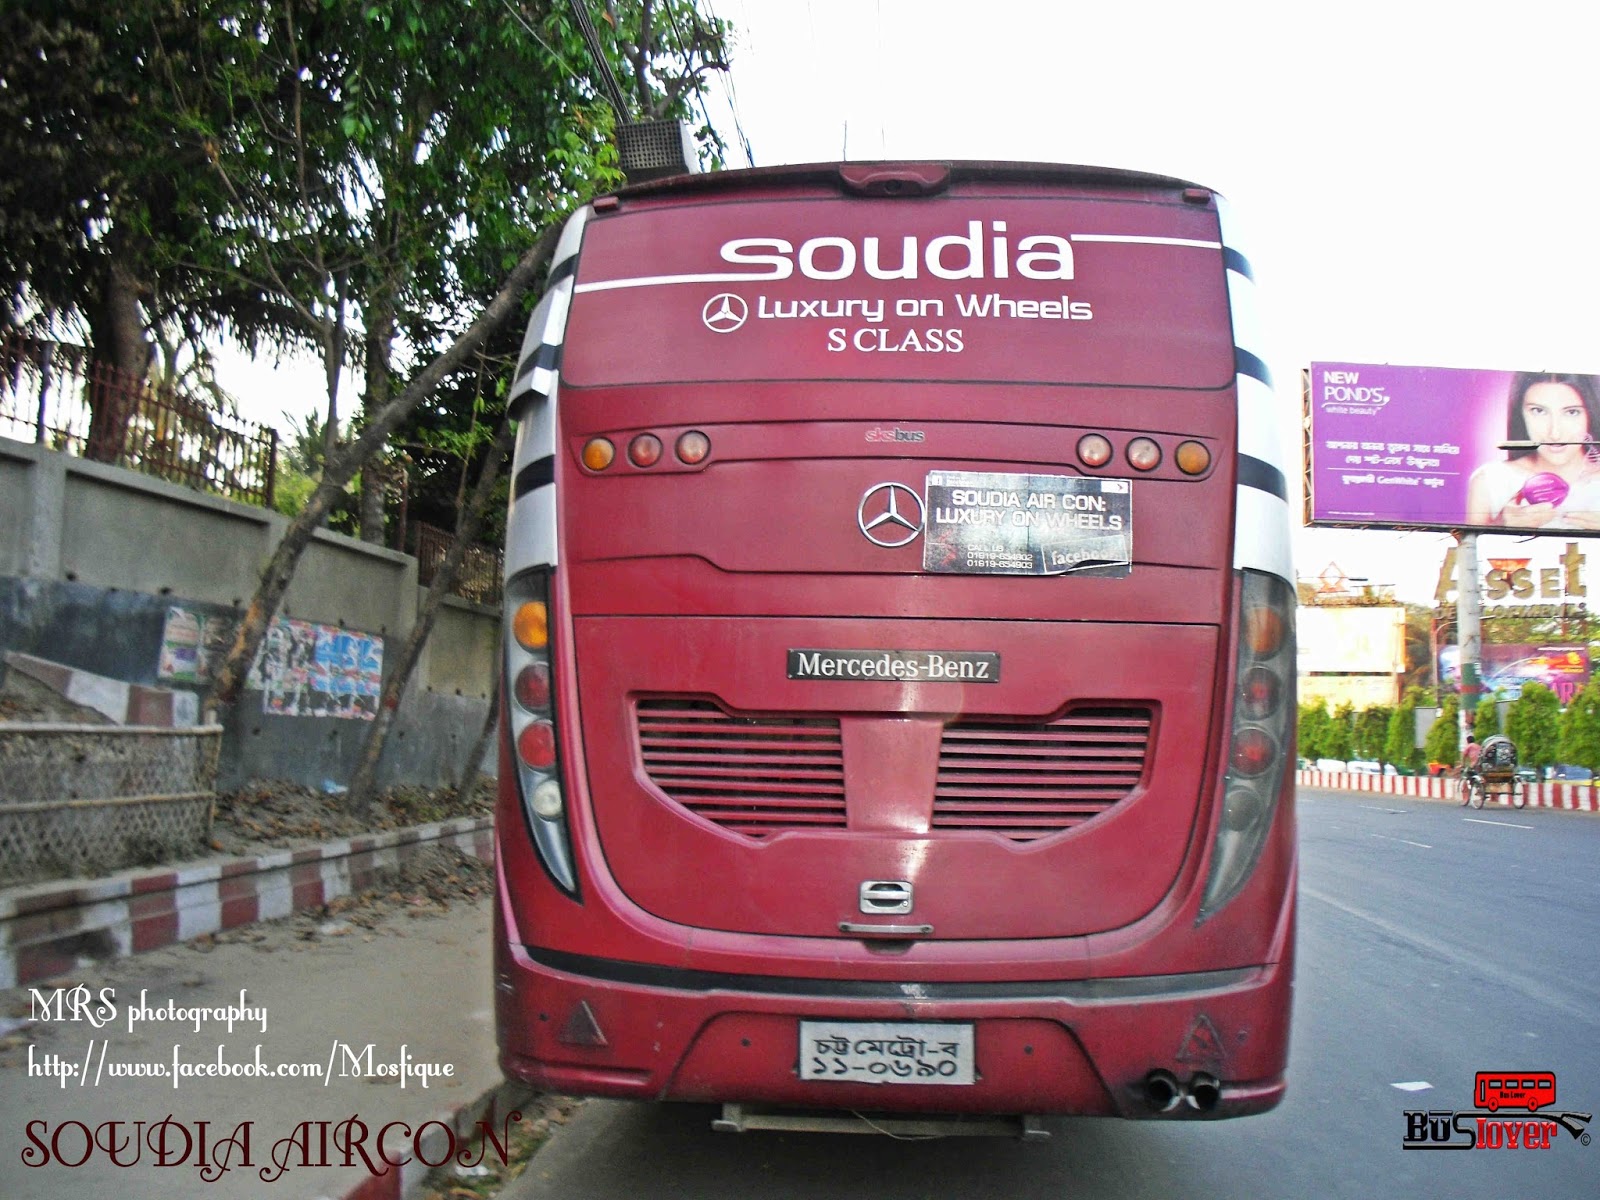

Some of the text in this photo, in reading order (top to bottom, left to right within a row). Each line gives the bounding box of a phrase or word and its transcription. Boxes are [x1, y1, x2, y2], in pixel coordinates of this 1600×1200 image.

[720, 220, 1074, 280] soudia
[758, 294, 1093, 322] Luxury on Wheels
[827, 328, 964, 353] S CLASS
[1324, 371, 1359, 384] NEW
[1325, 386, 1385, 402] POND'S
[952, 489, 1021, 508] SOUDIA
[1027, 492, 1056, 509] AIR
[936, 507, 1122, 531] LUXURY ON WHEELS
[797, 652, 989, 679] Mercedes-Benz
